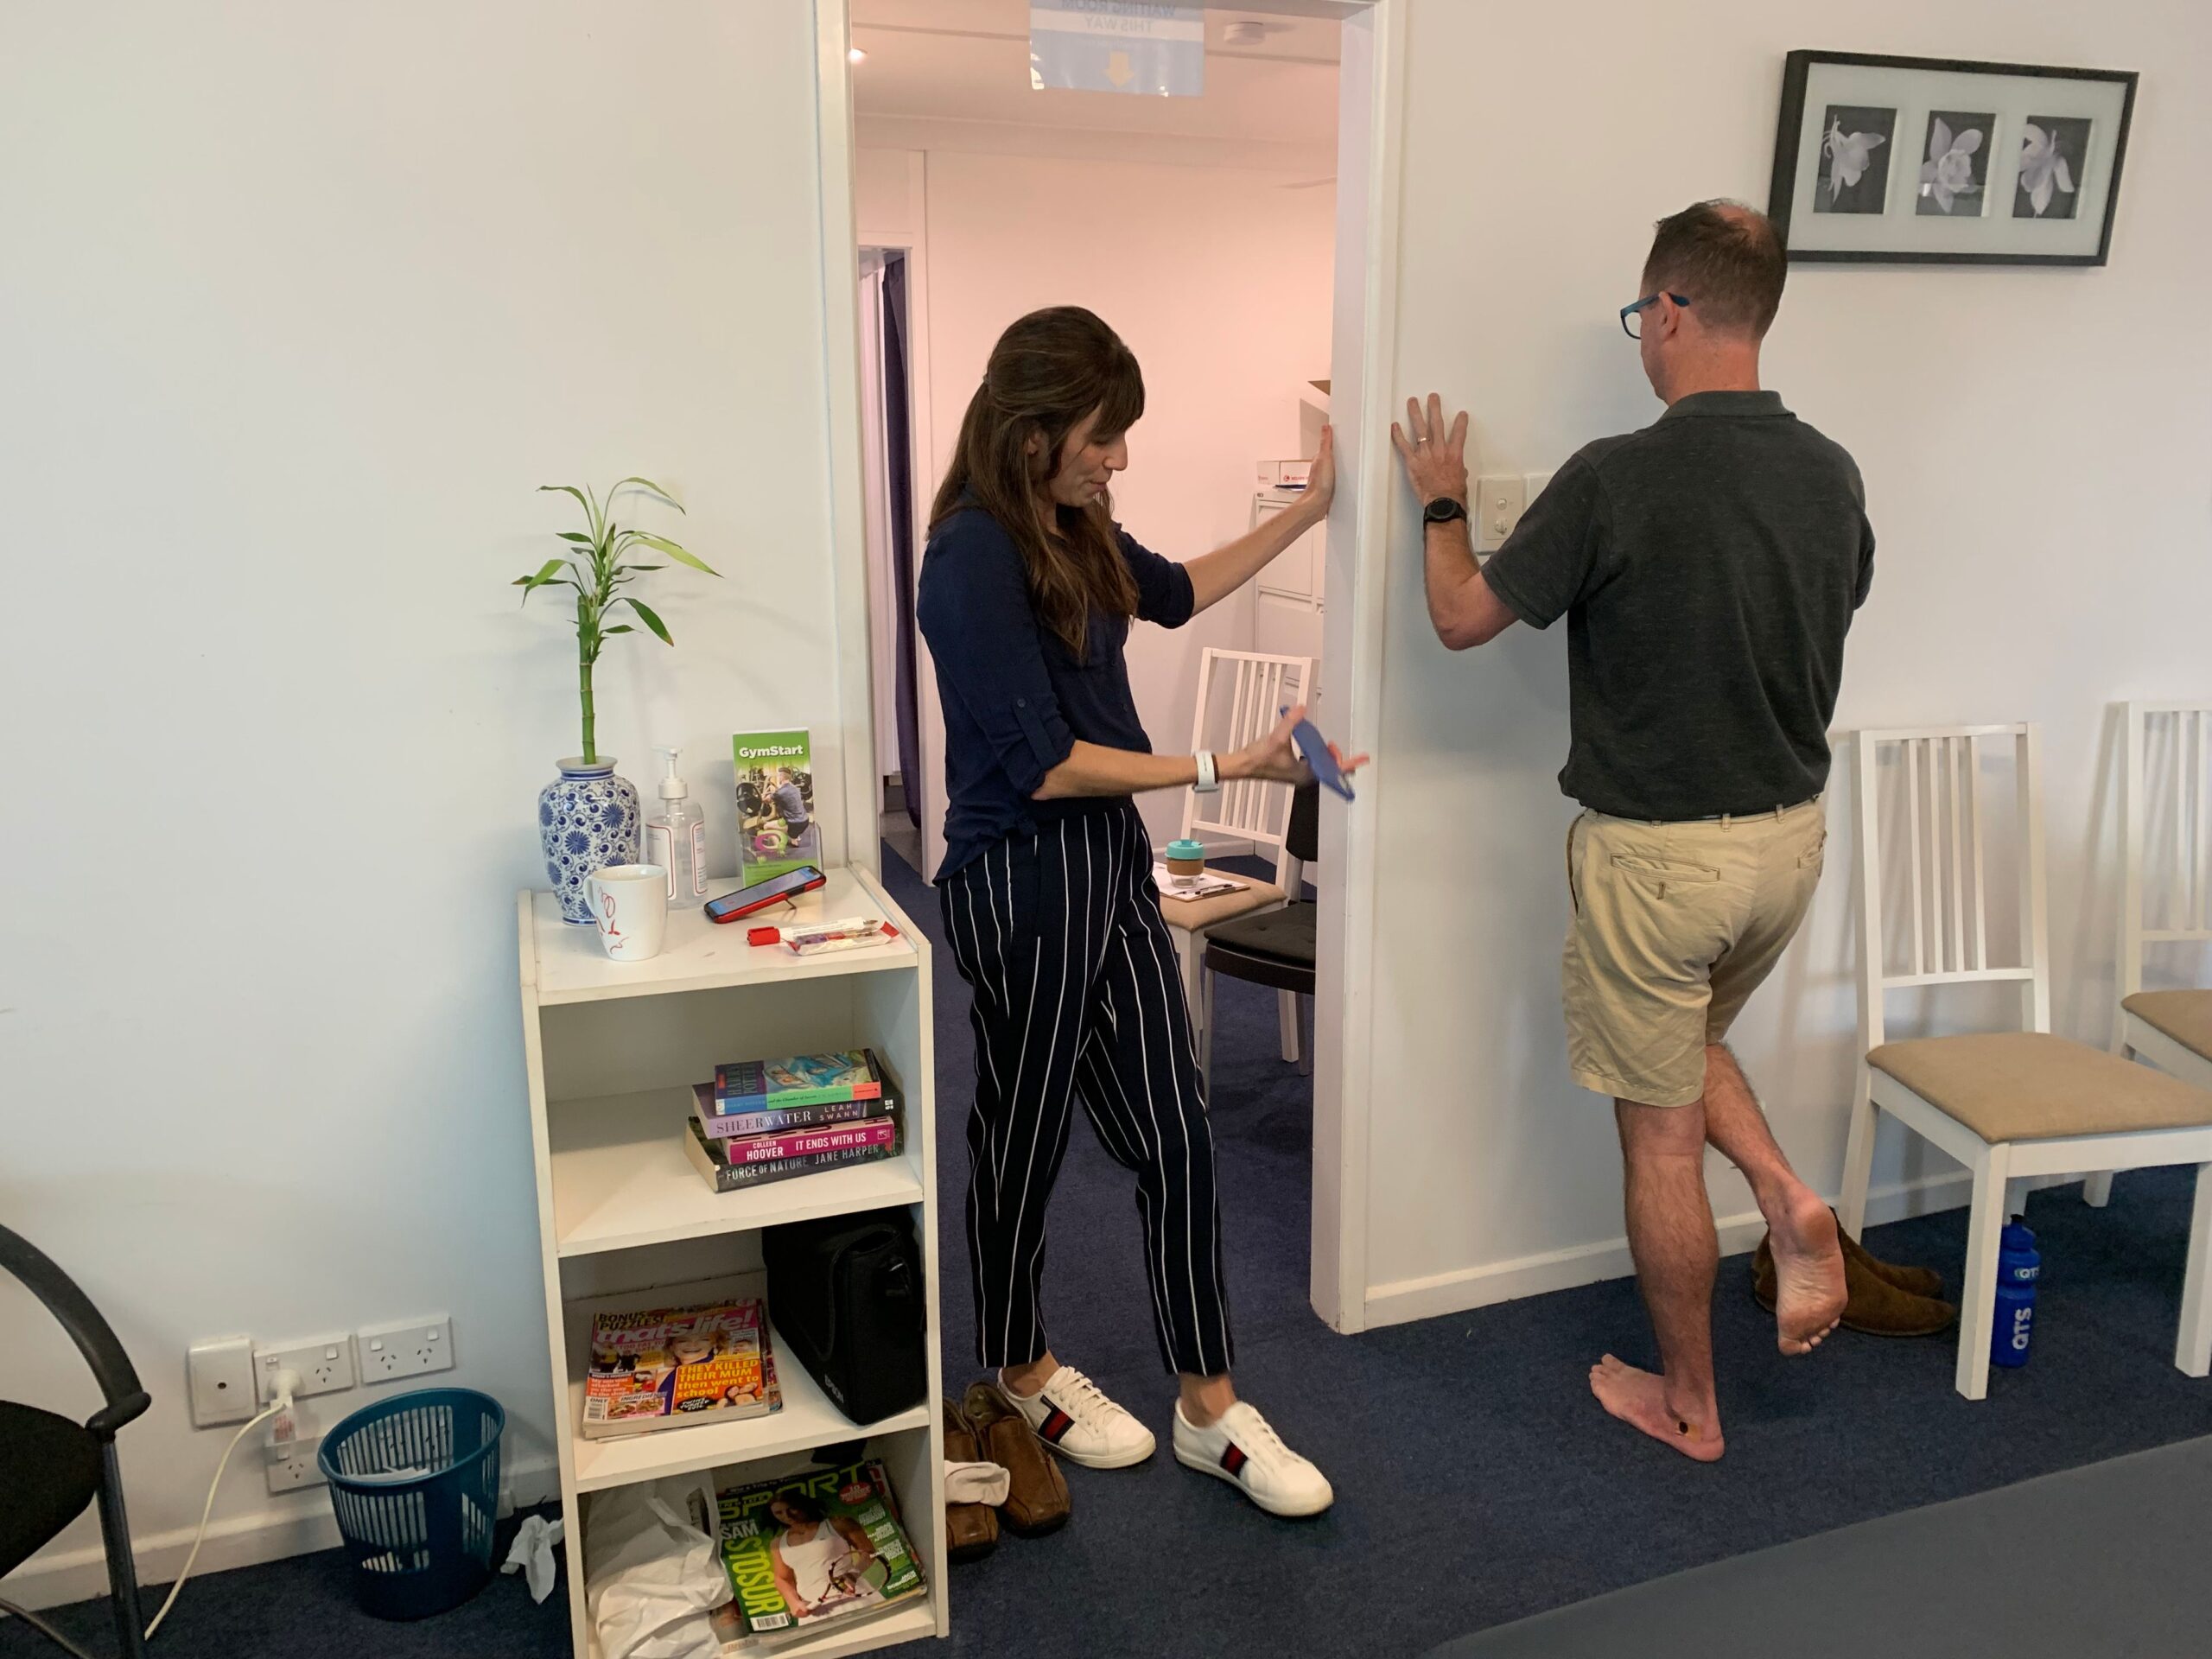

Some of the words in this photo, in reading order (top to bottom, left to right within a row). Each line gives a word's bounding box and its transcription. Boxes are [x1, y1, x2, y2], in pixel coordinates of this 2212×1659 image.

[738, 743, 804, 760] GymStart
[819, 1109, 859, 1122] SWANN
[824, 1103, 853, 1114] LEAH
[716, 1110, 812, 1134] SHEERWATER
[753, 1140, 777, 1148] COLLEEN
[796, 1141, 804, 1151] IT
[805, 1137, 830, 1149] ENDS
[830, 1134, 854, 1147] WITH
[855, 1132, 867, 1143] US
[747, 1147, 784, 1160] HOOVER
[726, 1165, 757, 1180] FORCE
[759, 1164, 768, 1175] OF
[770, 1157, 808, 1173] NATURE
[815, 1151, 838, 1165] JANE
[842, 1144, 880, 1160] HARPER
[599, 1312, 646, 1323] BONUS
[600, 1316, 664, 1331] PUZZLES!
[693, 1309, 754, 1334] life!
[2012, 1307, 2032, 1350] QTS
[680, 1363, 713, 1375] THEY
[715, 1359, 759, 1370] KILLED
[679, 1371, 716, 1382] THEIR
[720, 1368, 753, 1378] MUM
[678, 1380, 708, 1390] then
[711, 1376, 744, 1387] went
[677, 1386, 719, 1398] school
[721, 1521, 760, 1541] SAM
[724, 1536, 785, 1616] STOSUR
